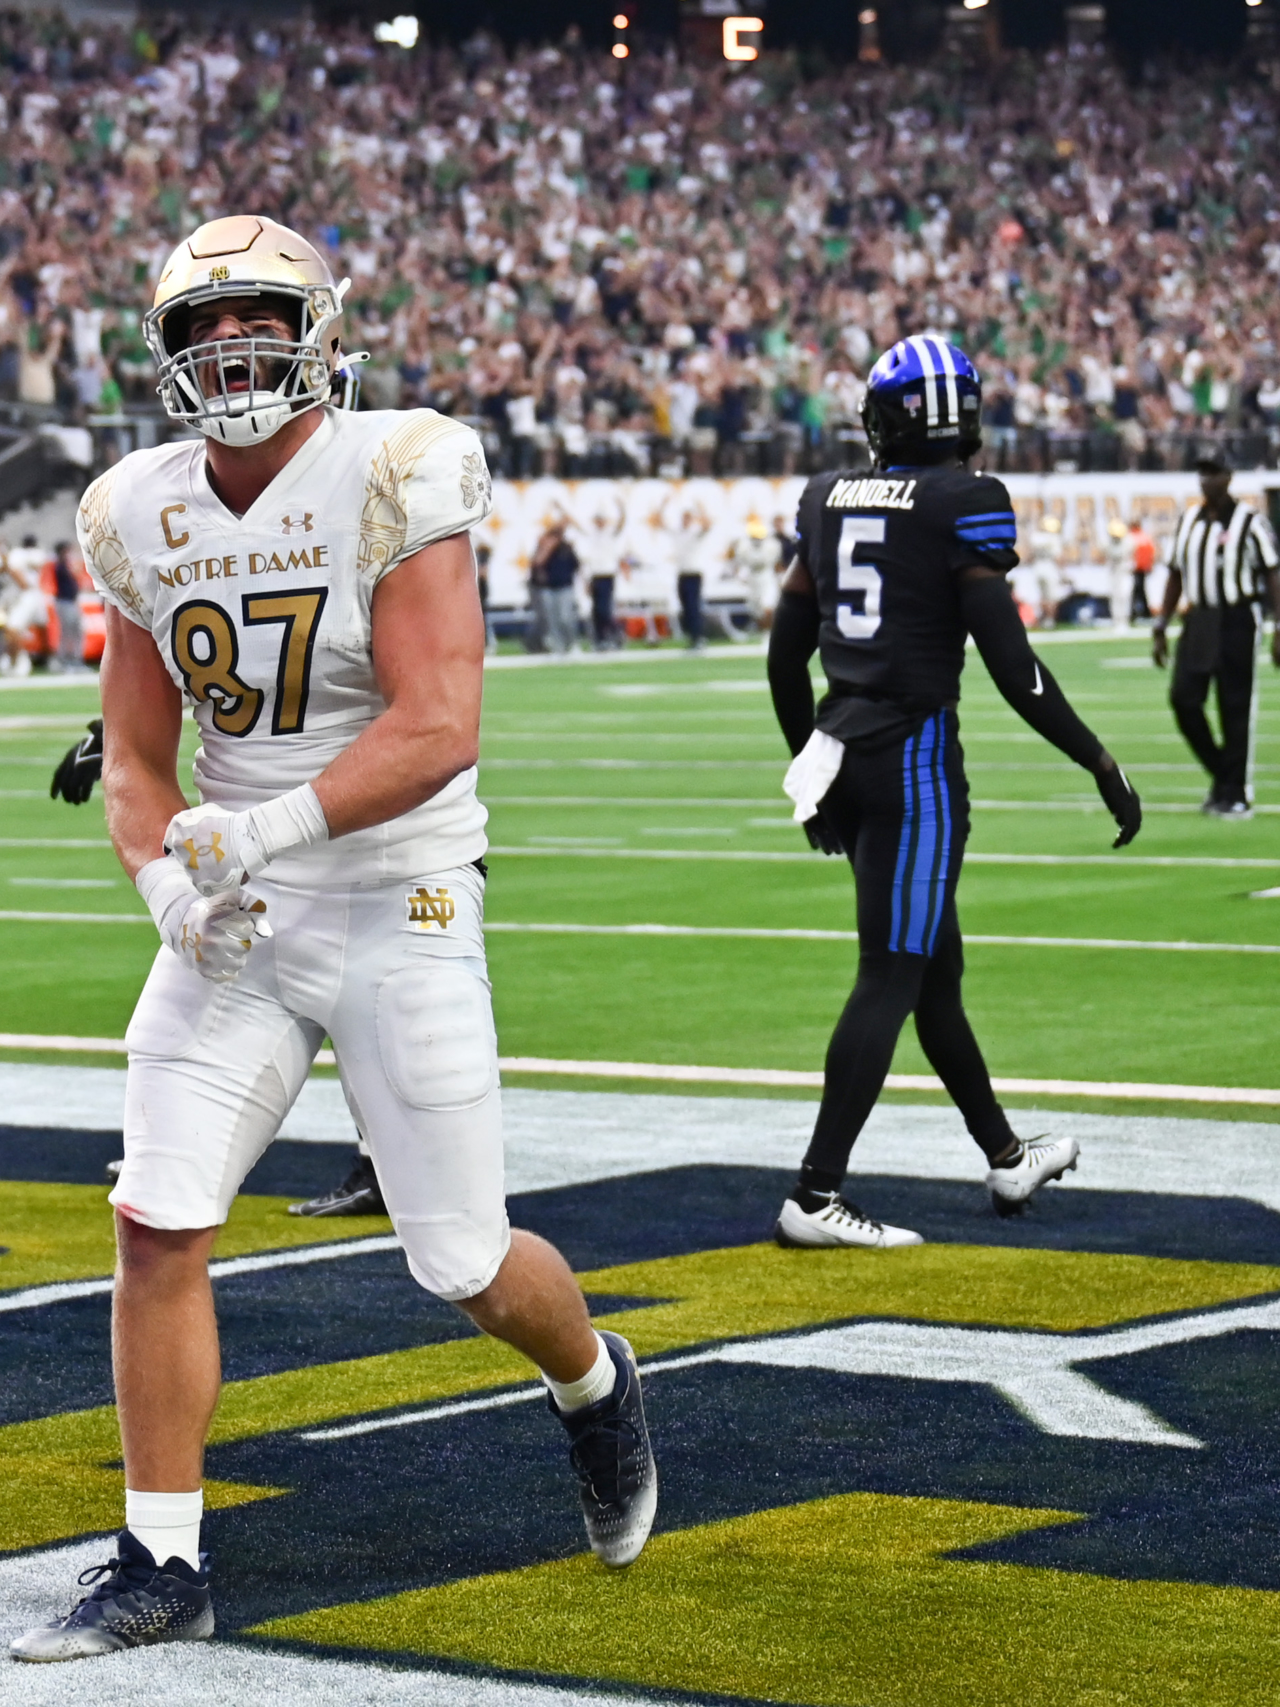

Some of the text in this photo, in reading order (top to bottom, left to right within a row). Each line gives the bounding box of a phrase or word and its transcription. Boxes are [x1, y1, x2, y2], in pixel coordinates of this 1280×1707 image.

[826, 479, 917, 510] MANDELL
[160, 503, 190, 549] C
[157, 545, 330, 590] NOTRE DAME
[837, 515, 887, 639] 5
[171, 586, 329, 738] 87
